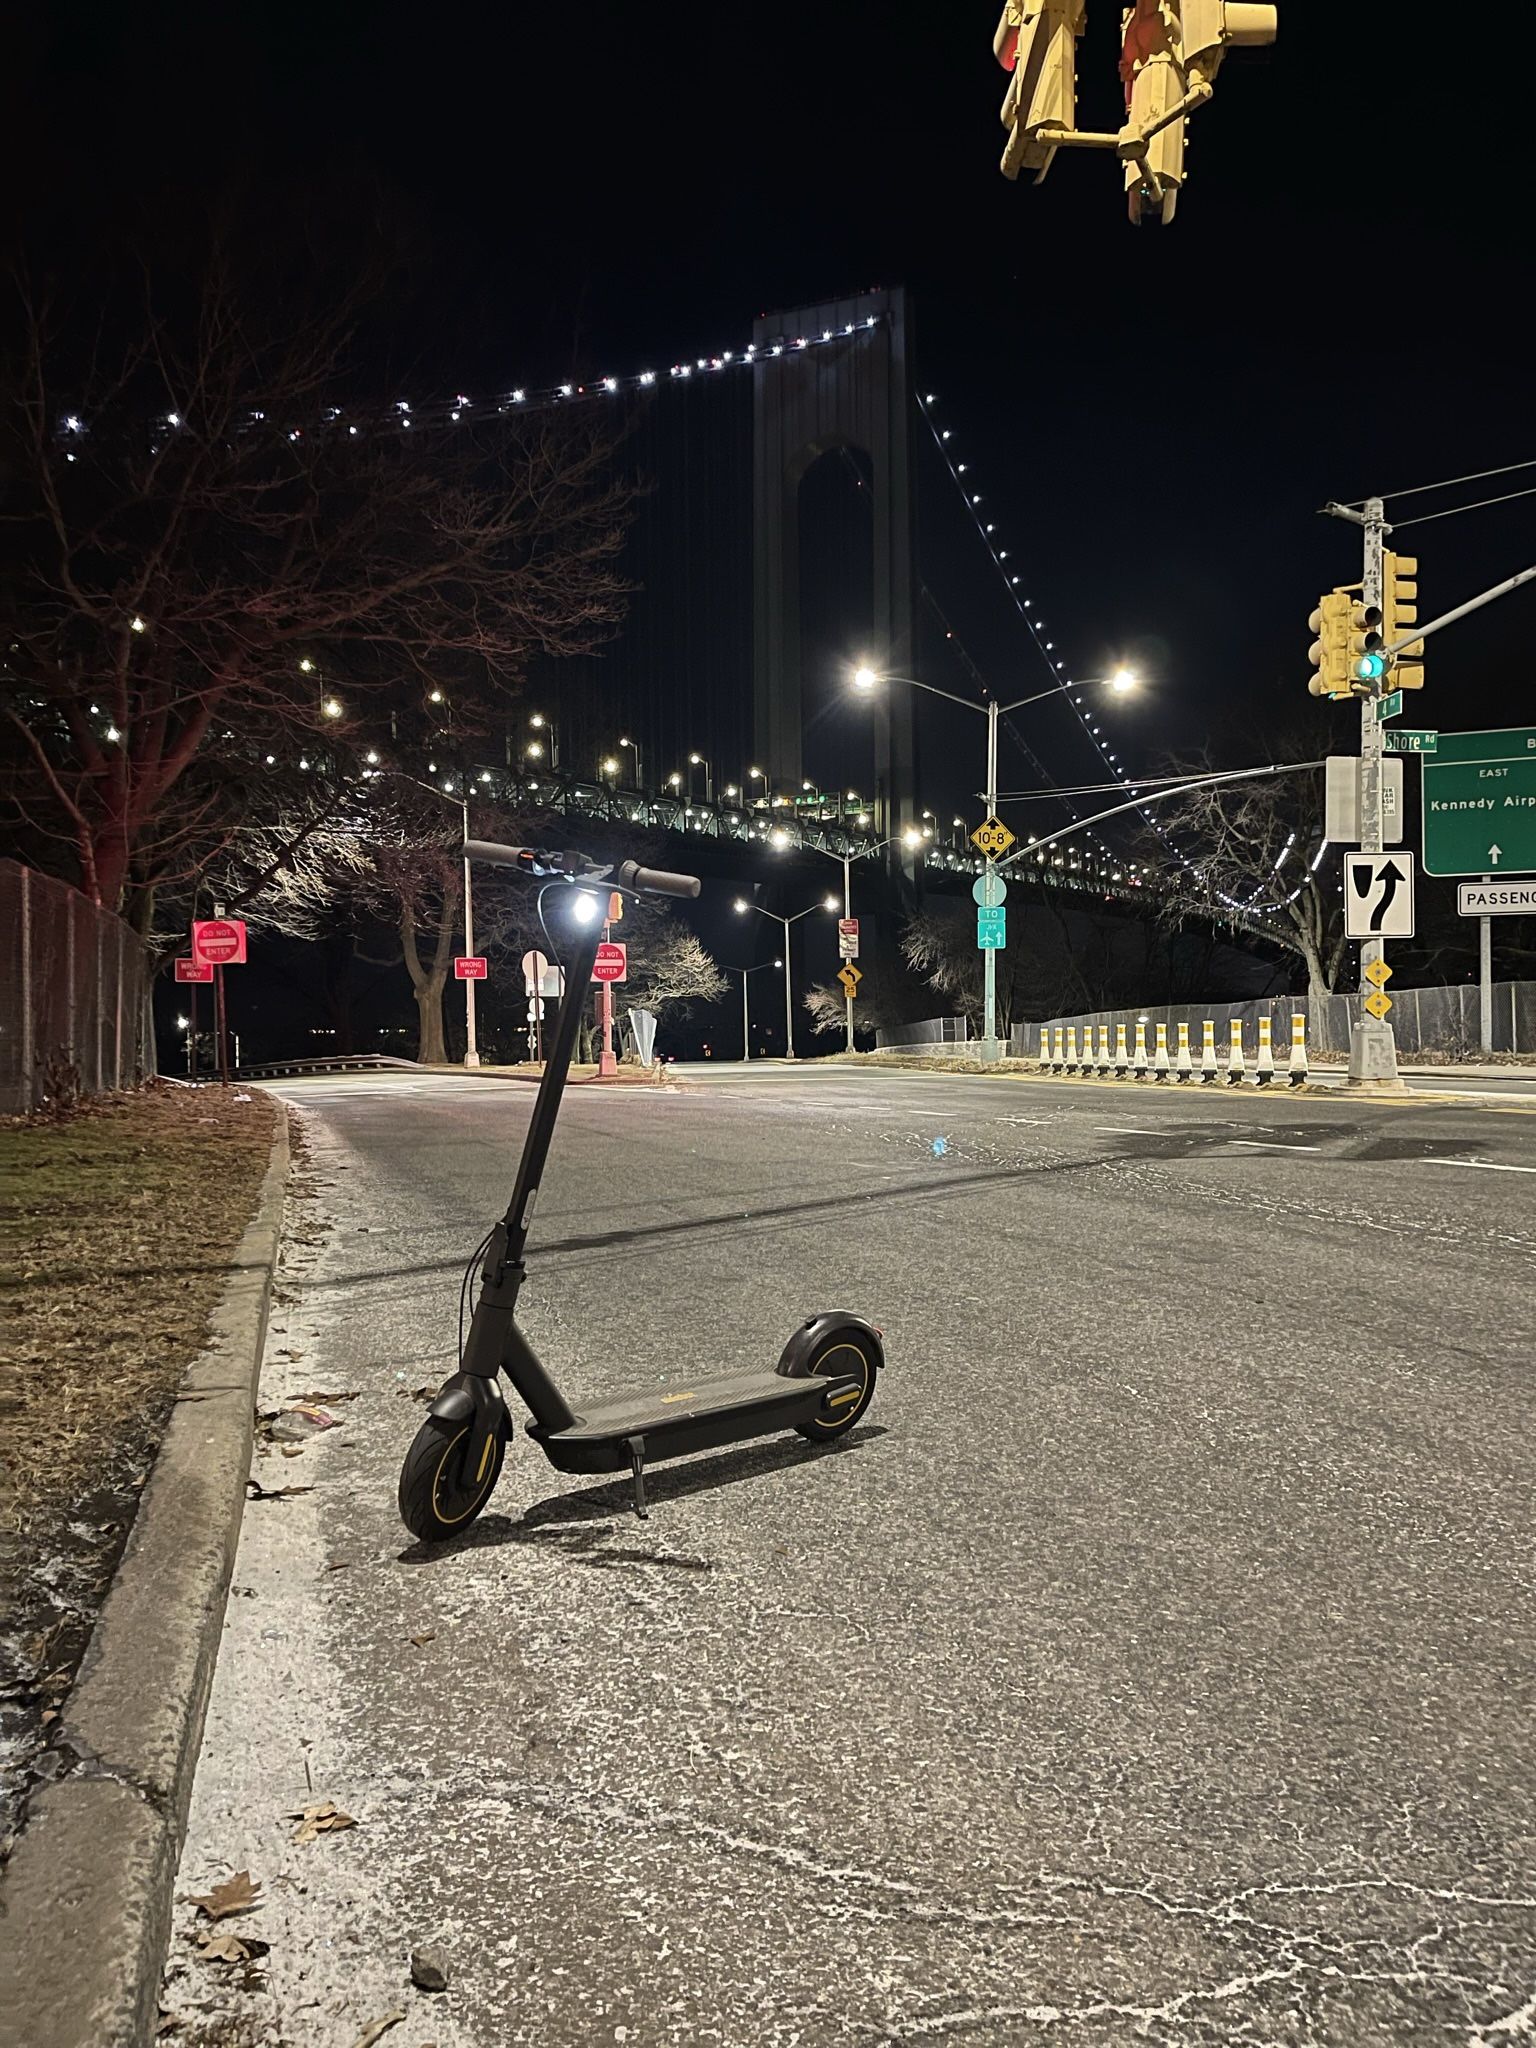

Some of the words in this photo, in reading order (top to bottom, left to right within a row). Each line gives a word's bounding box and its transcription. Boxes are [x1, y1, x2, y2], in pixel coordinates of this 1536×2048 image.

[1386, 733, 1420, 750] Shore
[1425, 734, 1435, 743] Rd
[1479, 768, 1509, 777] EAST
[1431, 798, 1495, 811] Kennedy
[1503, 795, 1536, 807] Airp
[985, 910, 998, 919] TO
[206, 947, 231, 955] ENTER
[186, 970, 202, 979] WAY
[597, 967, 618, 975] ENTER
